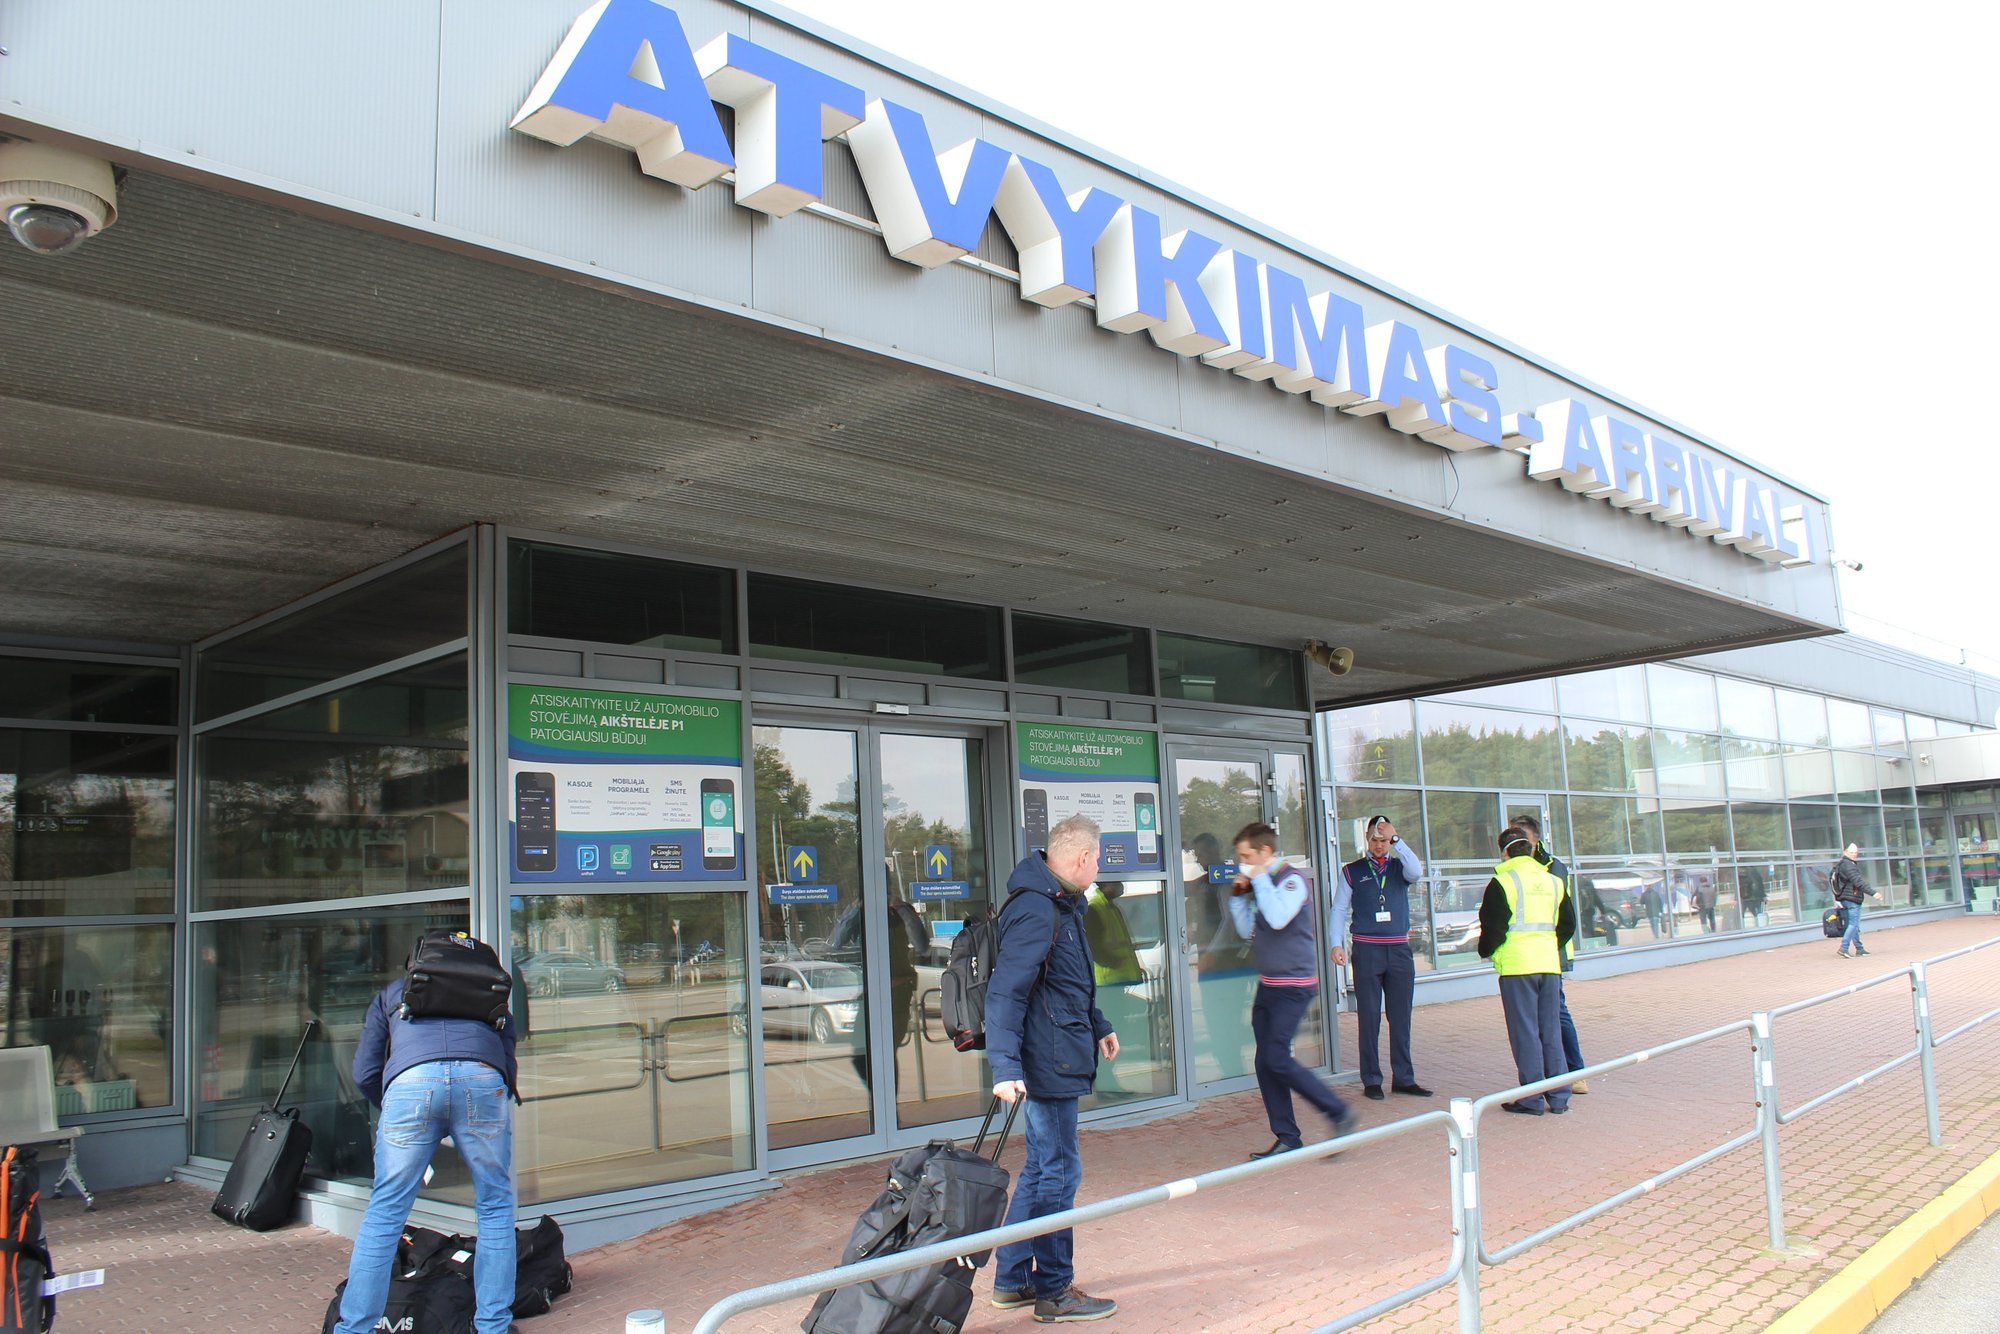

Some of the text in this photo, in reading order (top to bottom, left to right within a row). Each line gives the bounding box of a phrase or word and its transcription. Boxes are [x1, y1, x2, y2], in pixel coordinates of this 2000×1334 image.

[512, 0, 1502, 452] ATVYKIMAS
[1530, 398, 1799, 565] ARRIVAL
[530, 694, 720, 718] ATSISKAITYKITE UŽ AUTOMOBILIO
[530, 711, 684, 731] STOVĖJIMĄ AIKŠTELĖJE P1
[530, 728, 647, 745] PATOGIAUSIU BŪDU!
[1029, 729, 1144, 746] ATSISKAITYKITE UŽ AUTOMOBILIO
[1029, 741, 1123, 756] STOVĖJIMĄ AIKŠTELĖJE P1
[1030, 755, 1078, 766] PATOGIAUSIU
[567, 780, 593, 788] KASOJE
